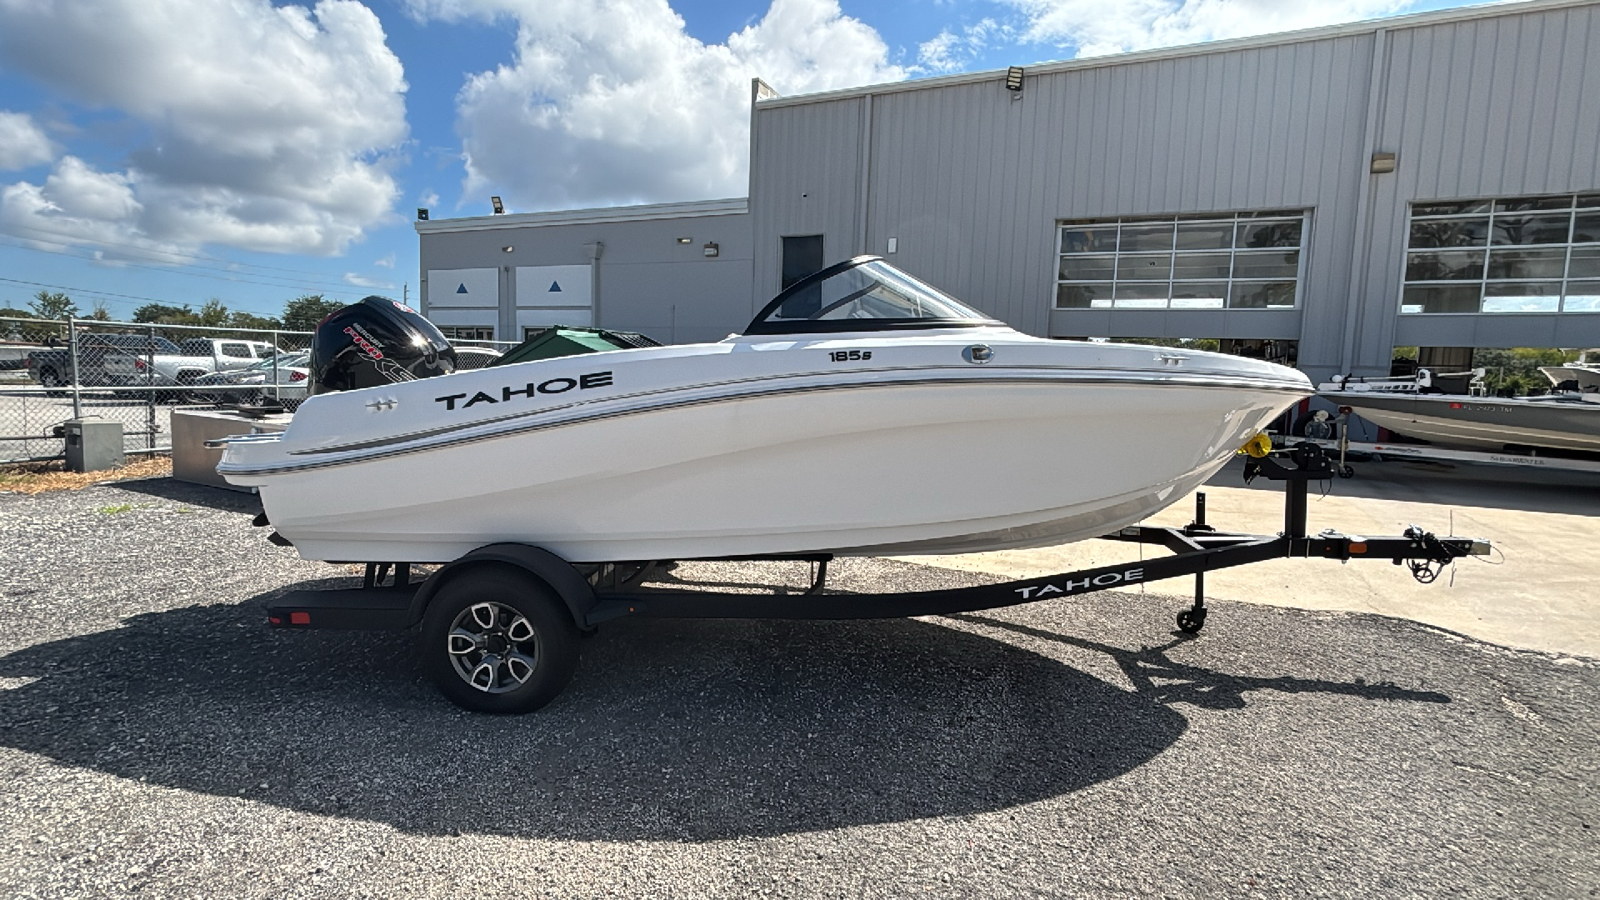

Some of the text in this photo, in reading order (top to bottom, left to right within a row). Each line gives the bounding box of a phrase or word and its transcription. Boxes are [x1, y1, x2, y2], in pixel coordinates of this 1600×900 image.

[352, 322, 385, 348] MERCURY
[435, 371, 613, 410] TAHOE
[1014, 568, 1144, 599] TAHOE
